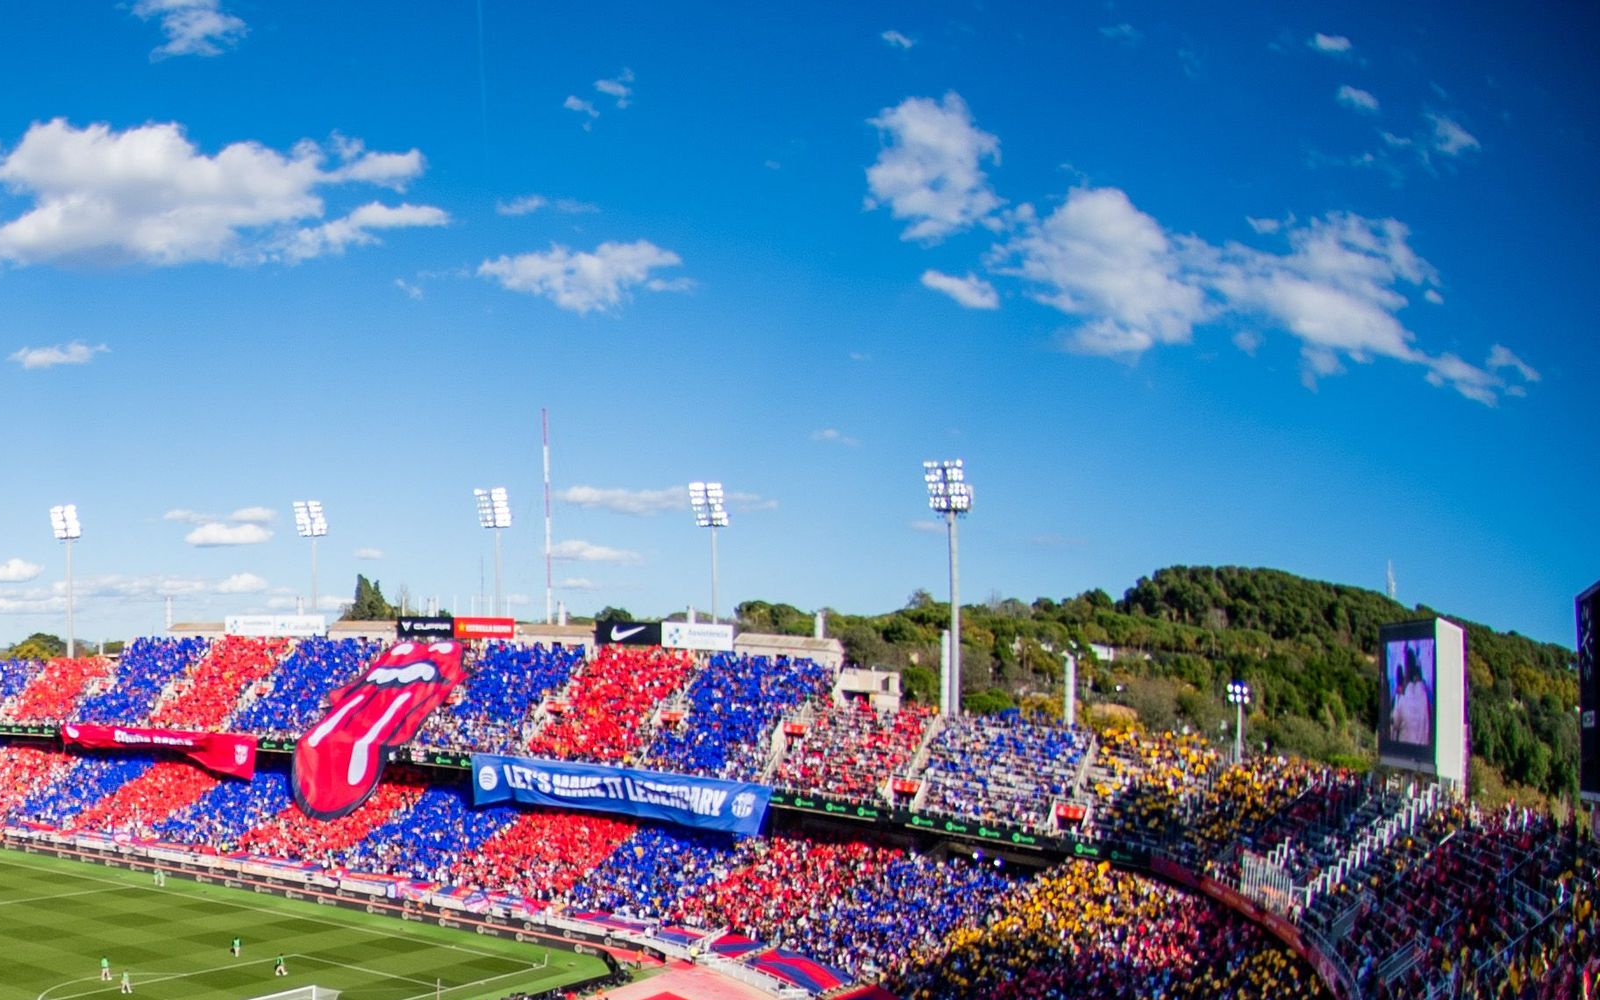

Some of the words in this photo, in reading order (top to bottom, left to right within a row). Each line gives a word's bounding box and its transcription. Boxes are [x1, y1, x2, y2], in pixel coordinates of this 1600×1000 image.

[413, 623, 451, 631] CUPRA
[503, 764, 551, 794] LET'S
[553, 773, 605, 797] MAKE
[603, 777, 624, 799] IT
[625, 778, 728, 816] LEGENDARY
